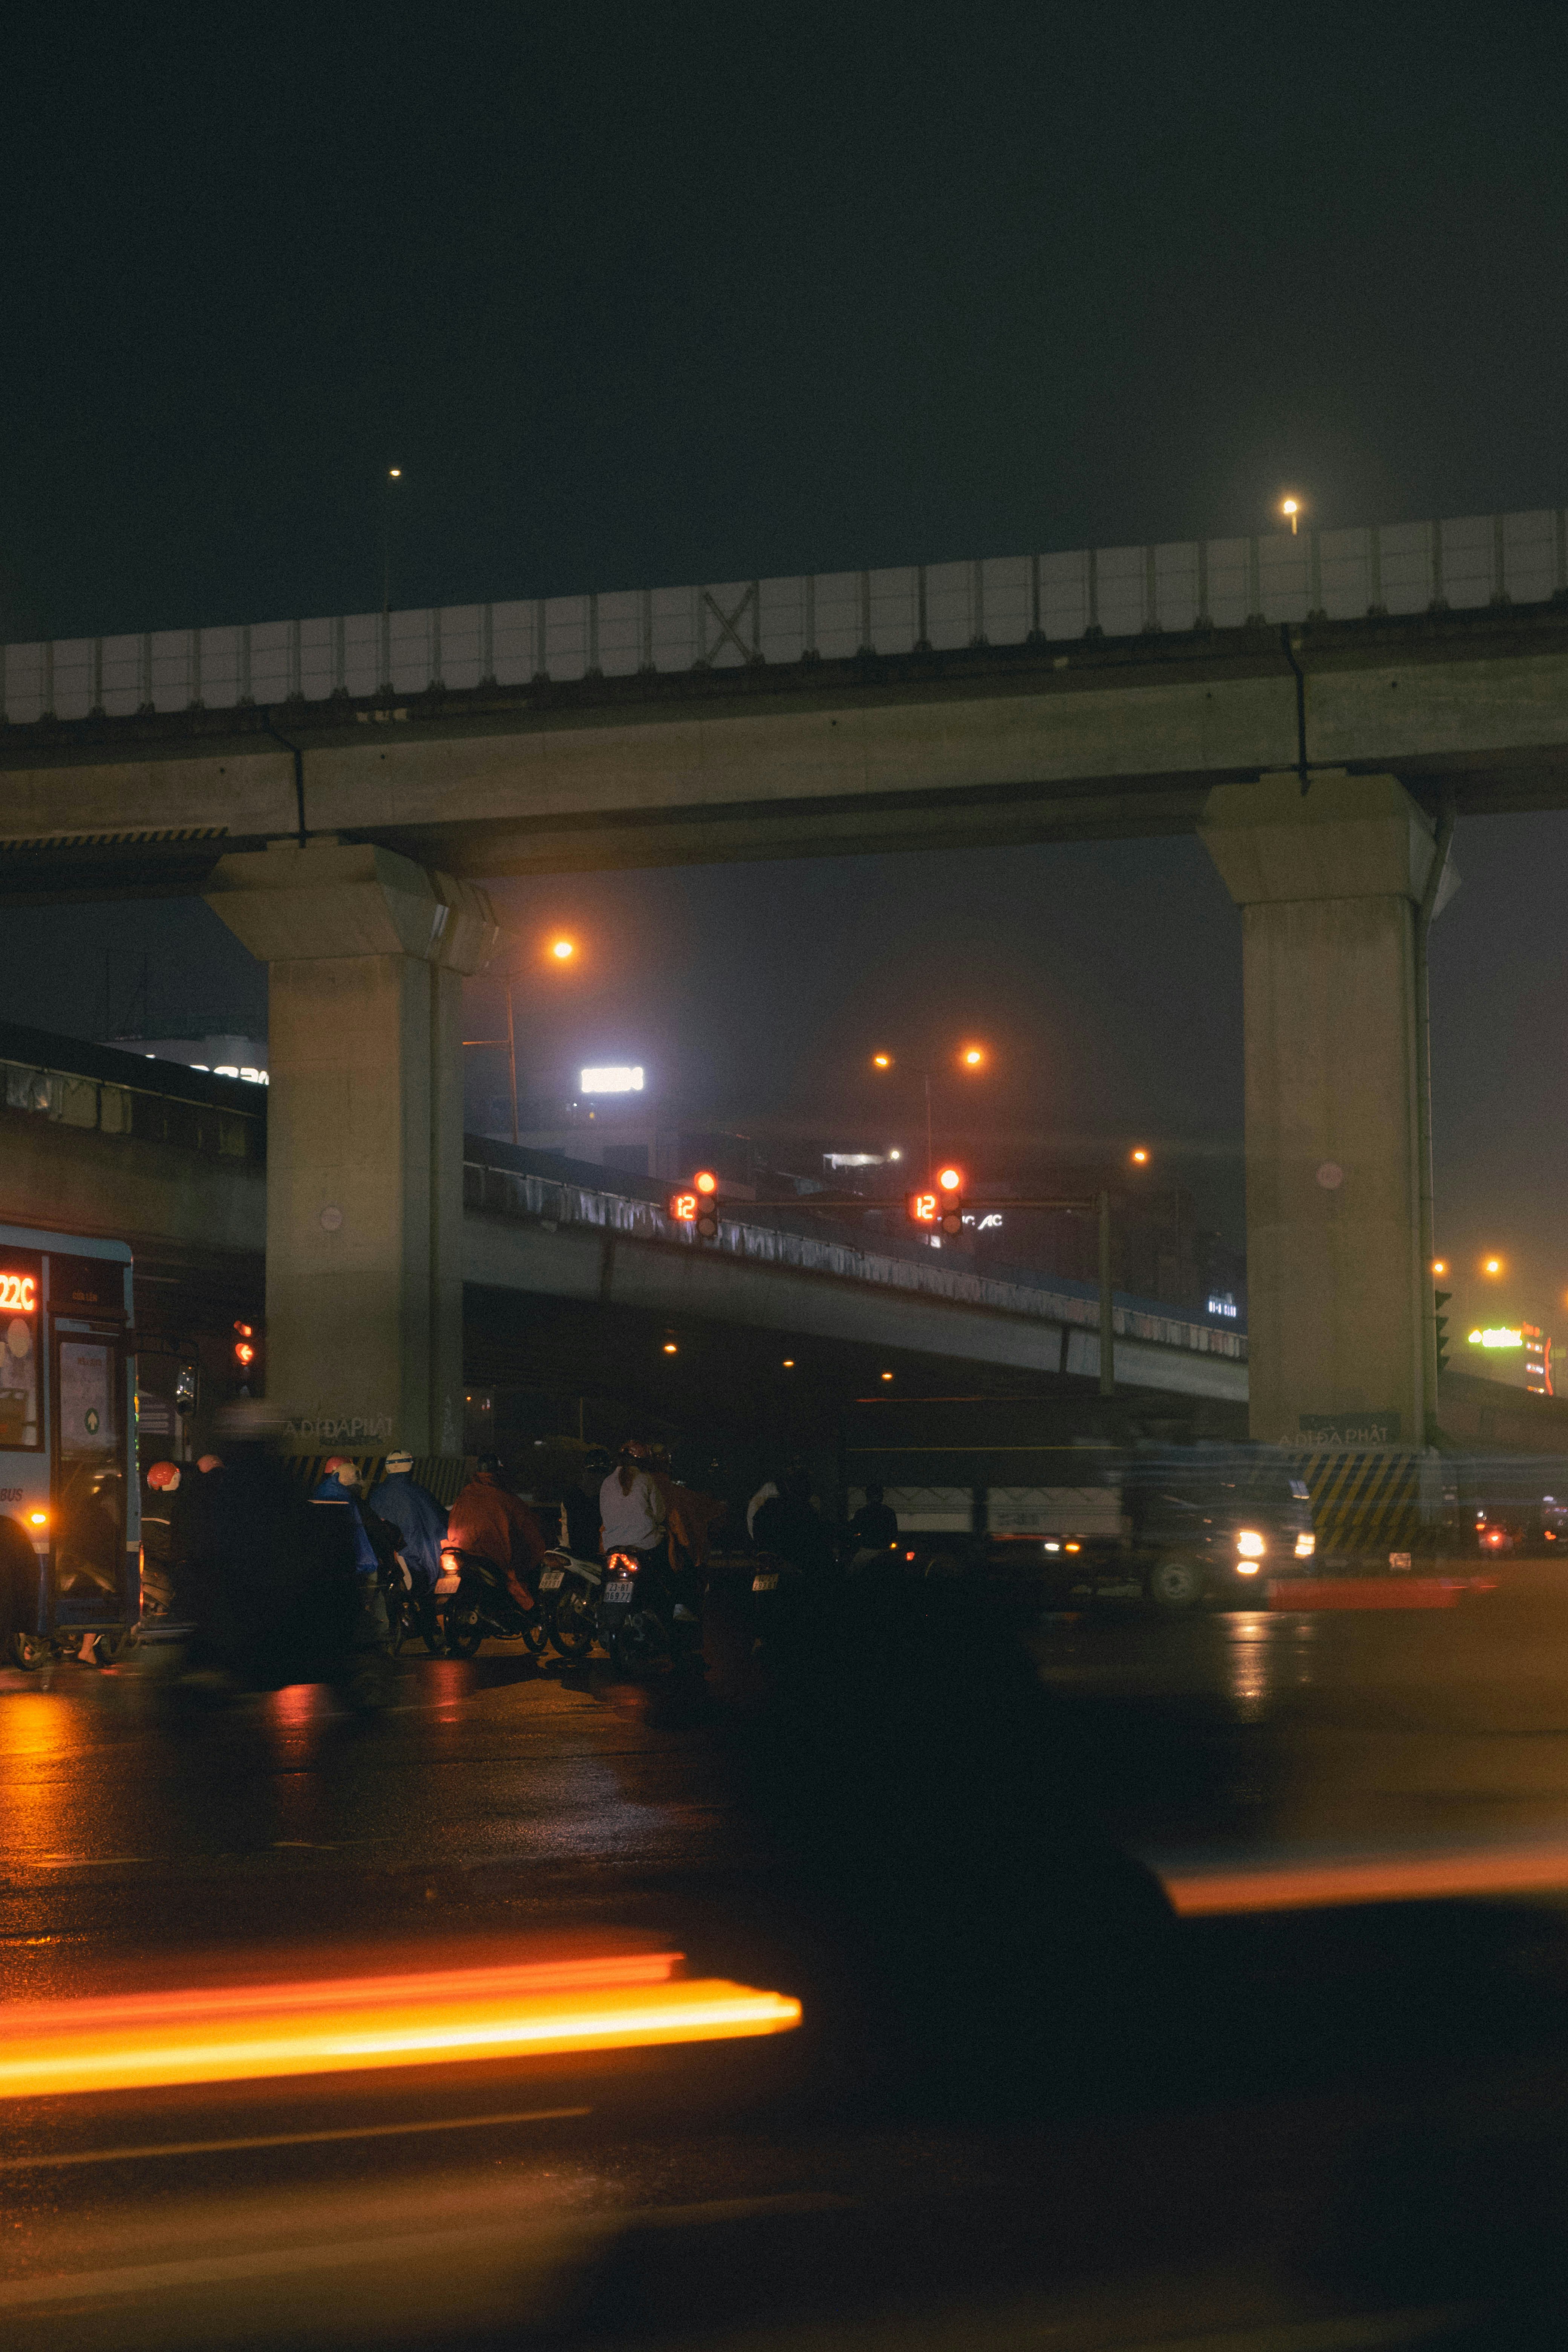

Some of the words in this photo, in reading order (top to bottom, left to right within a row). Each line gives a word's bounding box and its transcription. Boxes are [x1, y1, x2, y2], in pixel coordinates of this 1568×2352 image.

[677, 1196, 695, 1219] 12
[917, 1195, 936, 1219] 12
[0, 1274, 34, 1311] 22C
[283, 1421, 297, 1438] A
[1278, 1435, 1292, 1448] A
[0, 1488, 24, 1502] BUS
